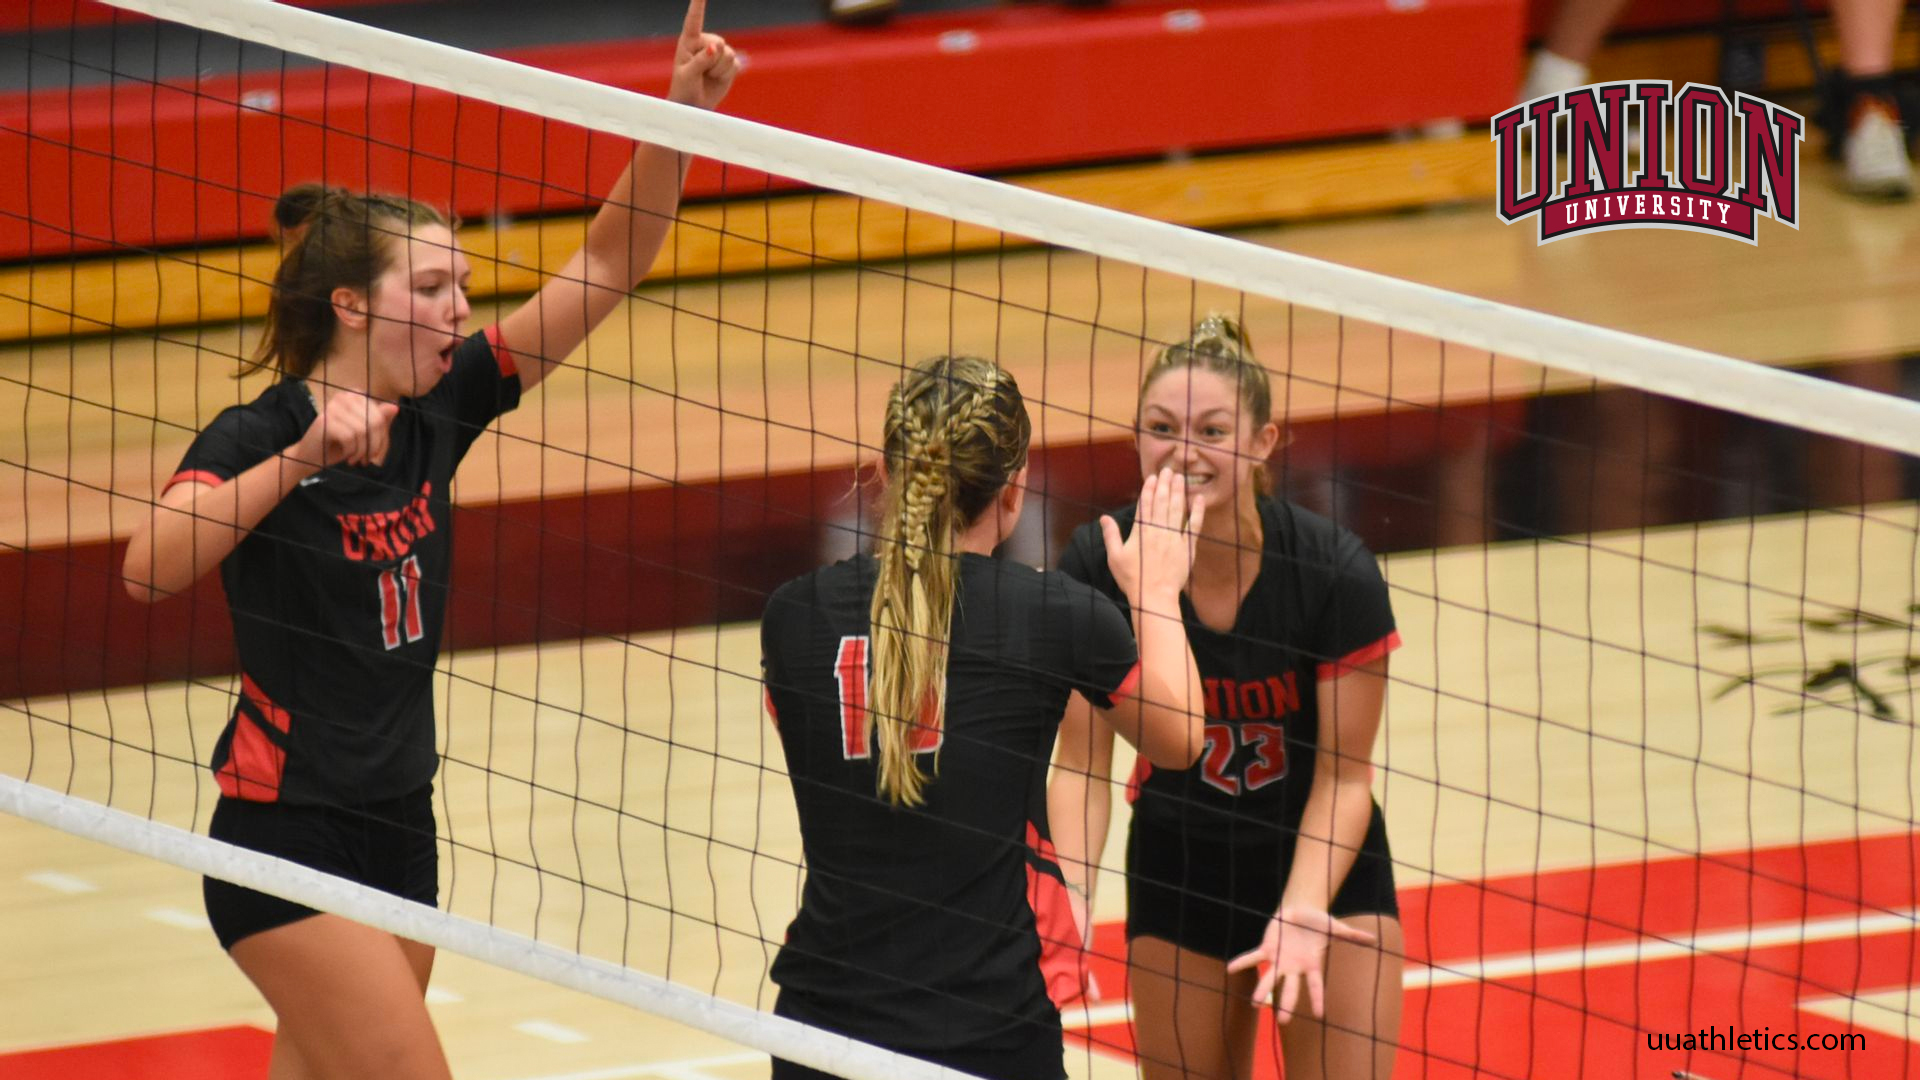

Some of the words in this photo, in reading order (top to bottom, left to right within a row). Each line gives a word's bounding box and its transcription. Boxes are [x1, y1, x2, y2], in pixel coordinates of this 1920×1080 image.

[337, 480, 436, 561] UNION
[378, 554, 424, 651] 11
[1201, 723, 1288, 796] 23
